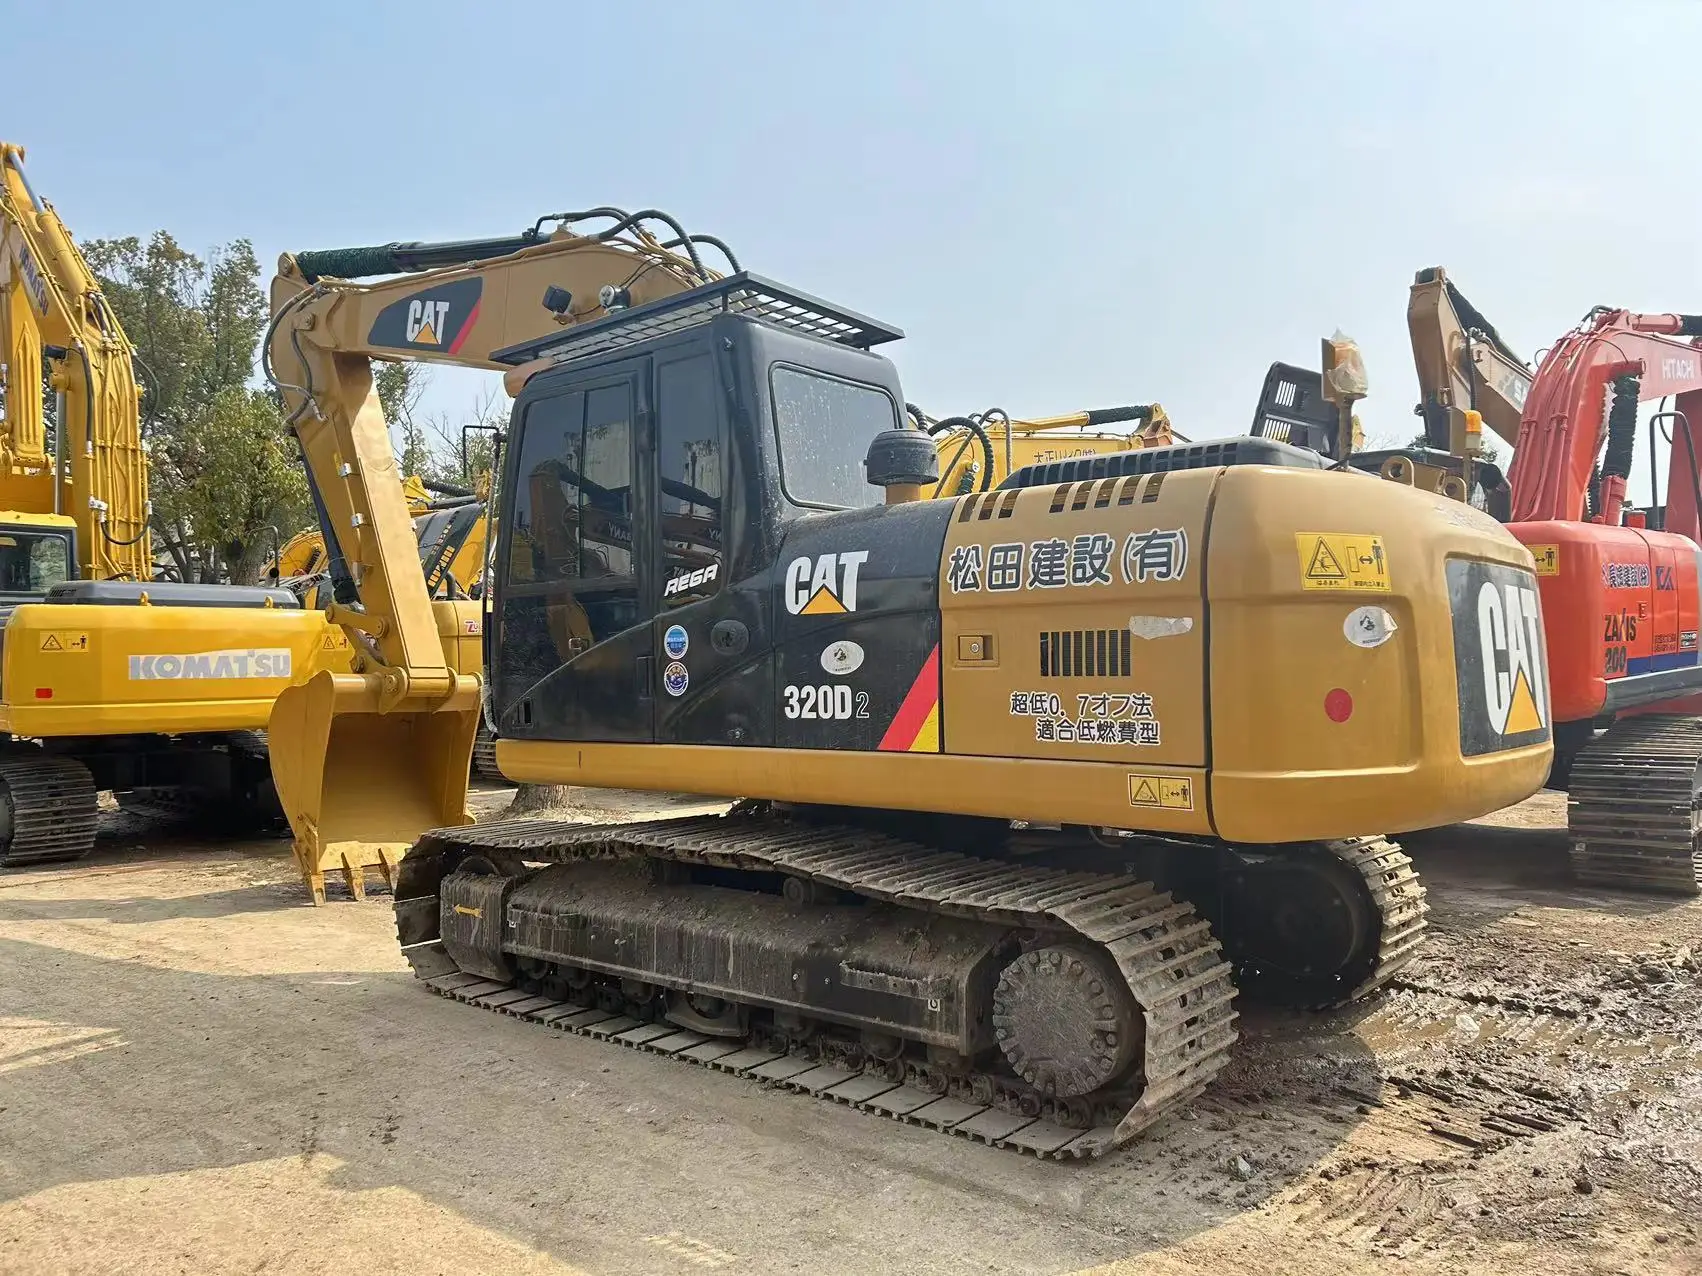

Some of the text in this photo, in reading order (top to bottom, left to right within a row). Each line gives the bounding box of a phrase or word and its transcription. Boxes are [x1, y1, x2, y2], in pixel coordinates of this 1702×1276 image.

[406, 299, 450, 344] CAT
[1662, 358, 1695, 380] HITACHI
[663, 563, 719, 597] REGA
[947, 527, 1188, 594] 松田建設(有)
[784, 550, 869, 615] CAT
[129, 650, 291, 680] KOMATSU
[1477, 582, 1547, 736] CAT
[1036, 718, 1161, 745] 適合低燃費型
